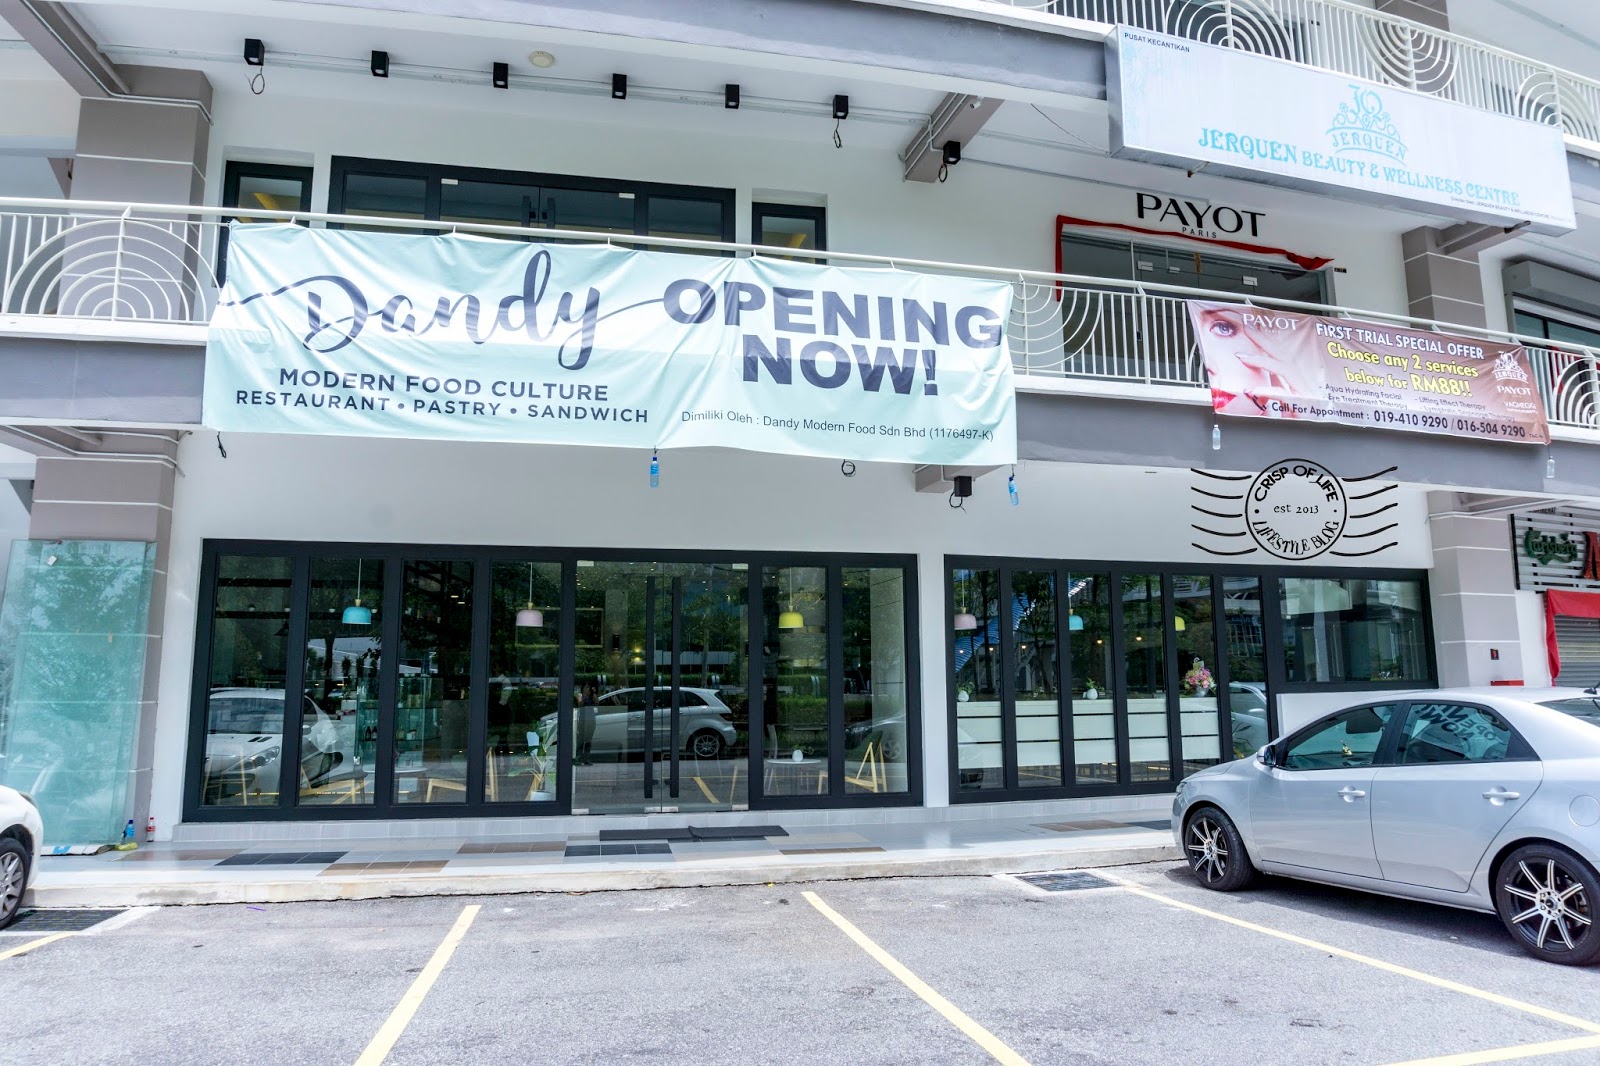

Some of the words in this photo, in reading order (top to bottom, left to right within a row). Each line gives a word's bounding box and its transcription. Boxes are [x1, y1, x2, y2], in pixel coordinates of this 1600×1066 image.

[1124, 32, 1146, 43] PUSAT
[1147, 37, 1190, 52] KECANTIKAN
[1332, 131, 1406, 160] JERQUEN
[1198, 127, 1298, 163] JERQUEN
[1301, 150, 1366, 177] BEAUTY
[1369, 163, 1379, 179] &
[1382, 166, 1463, 195] WELLNESS
[1465, 182, 1520, 206] CENTRE
[1136, 192, 1266, 237] PAYOT
[1181, 226, 1217, 238] PARIS
[217, 249, 664, 371] Dandy
[663, 278, 1003, 349] OPENING
[1242, 313, 1300, 330] PAYOT
[1315, 322, 1352, 340] FIRST
[1356, 328, 1394, 346] TRIAL
[1395, 335, 1445, 354] SPECIAL
[1447, 342, 1485, 360] OFFER
[742, 334, 938, 396] NOW!
[1326, 340, 1380, 364] Choose
[1384, 355, 1409, 371] any
[1412, 354, 1422, 370] 2
[1425, 360, 1479, 378] services
[279, 367, 396, 393] MODERN
[405, 375, 482, 396] FOOD
[491, 380, 609, 402] CULTURE
[1325, 383, 1344, 394] Aqua
[1345, 387, 1380, 399] Hydrating
[1381, 391, 1402, 400] Facial
[1344, 367, 1385, 387] below
[1387, 374, 1408, 390] for
[1410, 372, 1473, 398] RM88!!
[1497, 385, 1531, 396] PAYOT
[236, 390, 390, 412] RESTAURANT
[413, 399, 501, 417] PASTRY
[527, 404, 648, 424] SANDWICH
[1341, 395, 1378, 406] Treatment
[1460, 401, 1486, 411] Therapy
[681, 410, 723, 422] Dimiliki
[726, 410, 752, 424] Oleh
[763, 415, 800, 430] Dandy
[803, 419, 845, 432] Modern
[848, 422, 876, 434] Food
[879, 425, 901, 437] Sdn
[904, 427, 926, 438] Bhd
[929, 427, 993, 442] (1176497-K)
[1272, 402, 1290, 413] Call
[1292, 404, 1307, 414] For
[1309, 406, 1364, 420] Appointment
[1373, 410, 1418, 426] 019-410
[1421, 415, 1448, 429] 9290
[1457, 419, 1498, 434] 016-504
[1501, 424, 1526, 437] 9290
